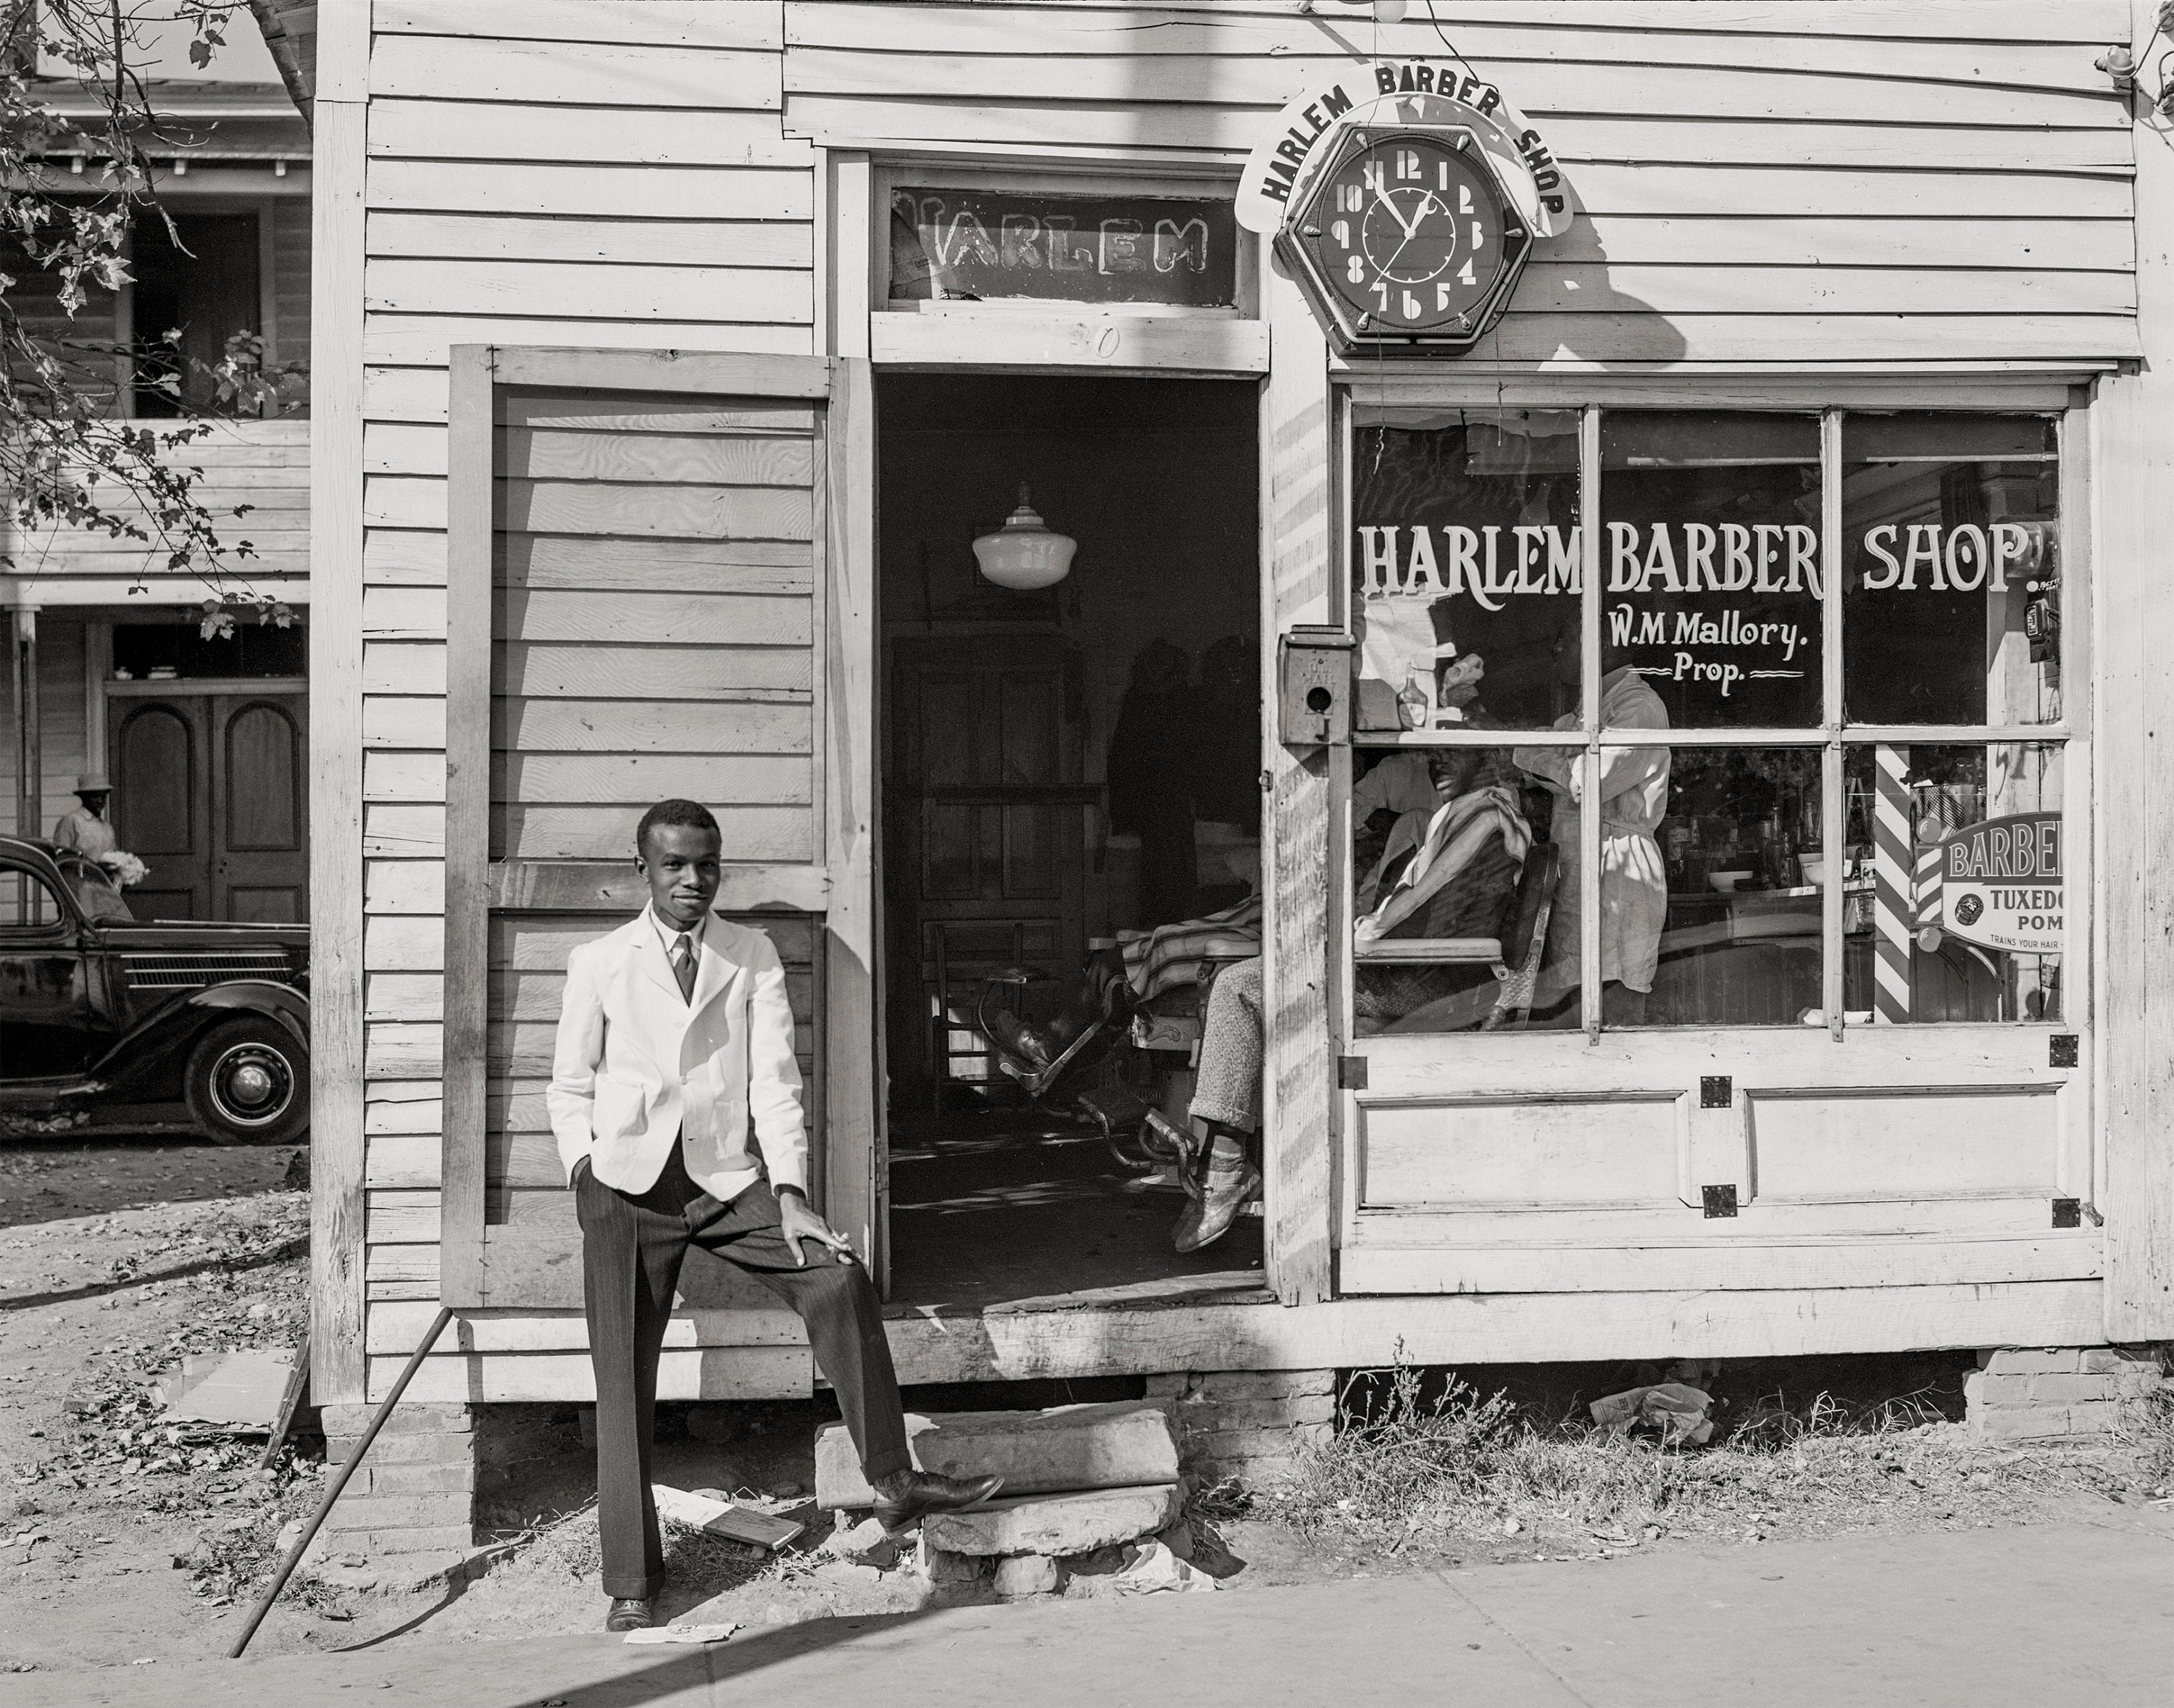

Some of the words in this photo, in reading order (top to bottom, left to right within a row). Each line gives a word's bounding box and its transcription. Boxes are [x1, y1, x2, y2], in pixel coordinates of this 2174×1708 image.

[1260, 85, 1354, 202] HARLEM
[1375, 65, 1500, 117] BARBER
[1513, 129, 1565, 214] SHOP
[1397, 150, 1422, 179] 12
[1439, 162, 1448, 191] 1
[1337, 184, 1363, 212] 10
[1459, 185, 1474, 214] 2
[1331, 220, 1349, 249] 9
[1472, 221, 1483, 250] 3
[1348, 255, 1365, 283] 8
[1457, 257, 1476, 285] 4
[1373, 283, 1387, 312] 7
[1403, 290, 1422, 320] 6
[1437, 283, 1450, 312] 5
[1357, 525, 1583, 612] HARLEM
[1607, 522, 1824, 601] BARBER
[1863, 523, 2039, 593] SHOP.
[1671, 609, 1808, 662] Mallory.
[1673, 652, 1745, 697] Prop.
[1990, 933, 2017, 946] TRAINS
[2019, 938, 2038, 949] YOUR
[2041, 941, 2059, 949] HAIR
